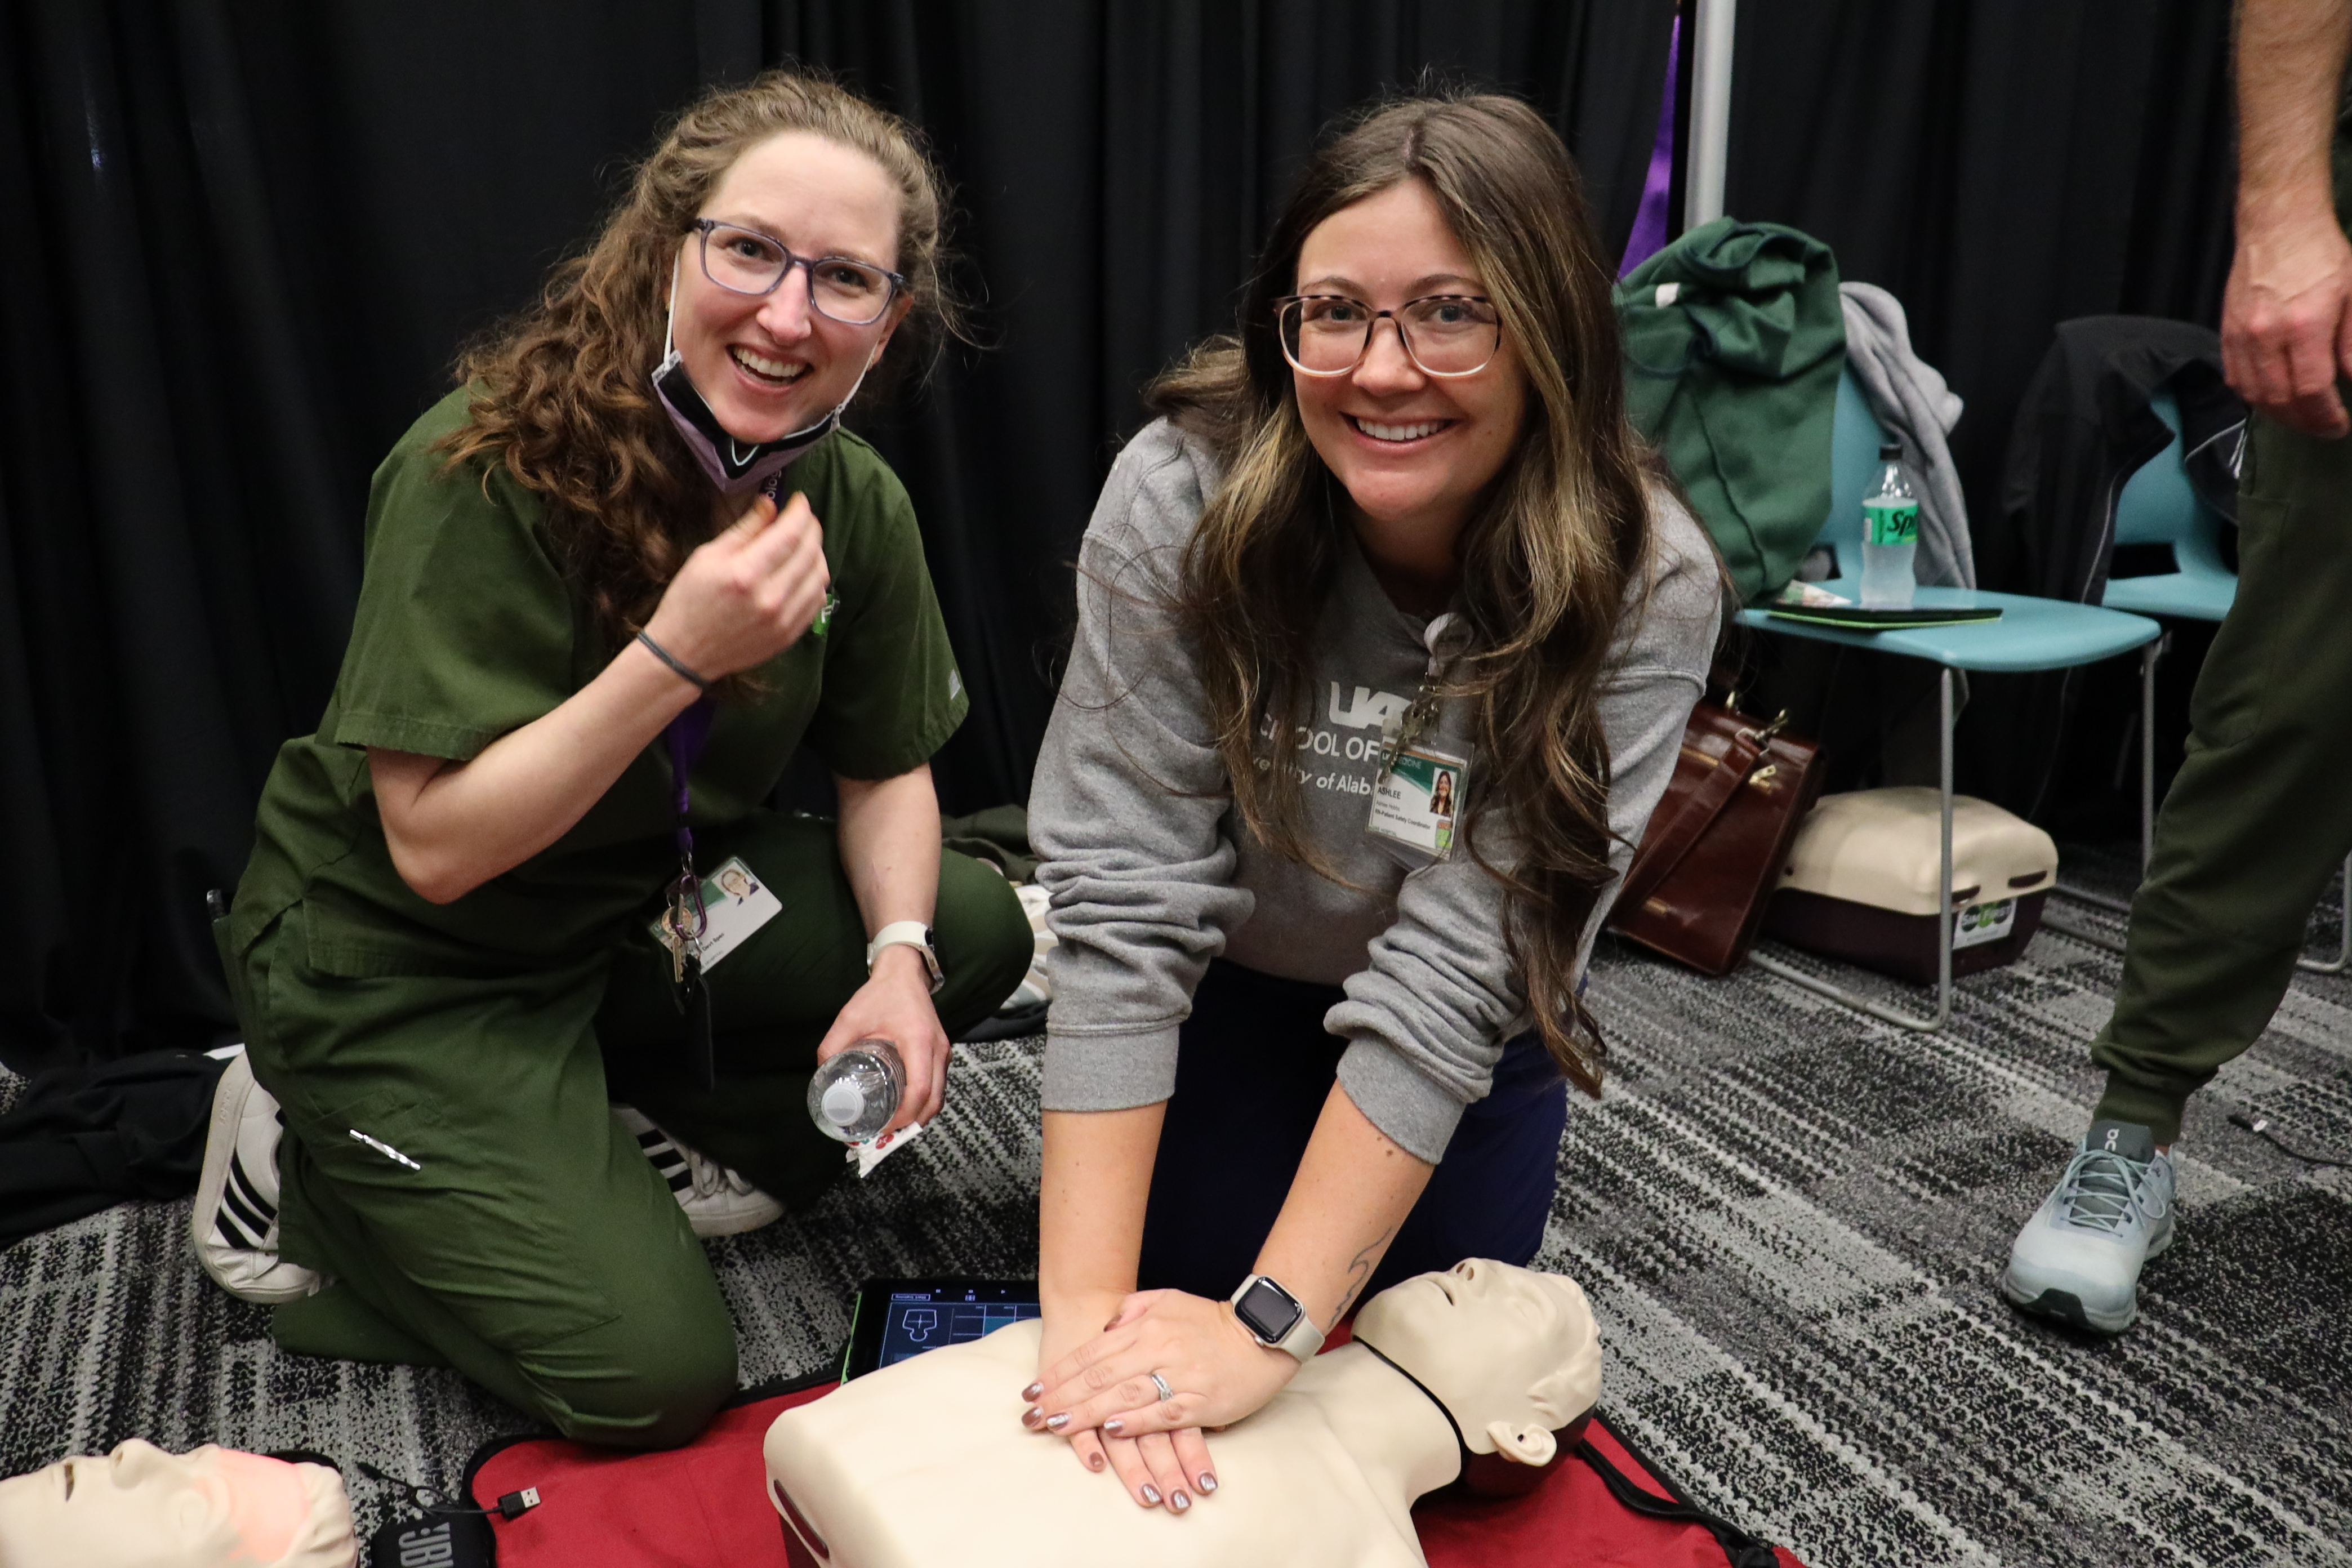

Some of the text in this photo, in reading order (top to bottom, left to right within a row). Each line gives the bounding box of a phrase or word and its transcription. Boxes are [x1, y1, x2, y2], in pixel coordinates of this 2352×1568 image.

[1346, 737, 1380, 761] OF
[1316, 772, 1374, 795] of Alab
[1378, 787, 1401, 799] ASHLEE
